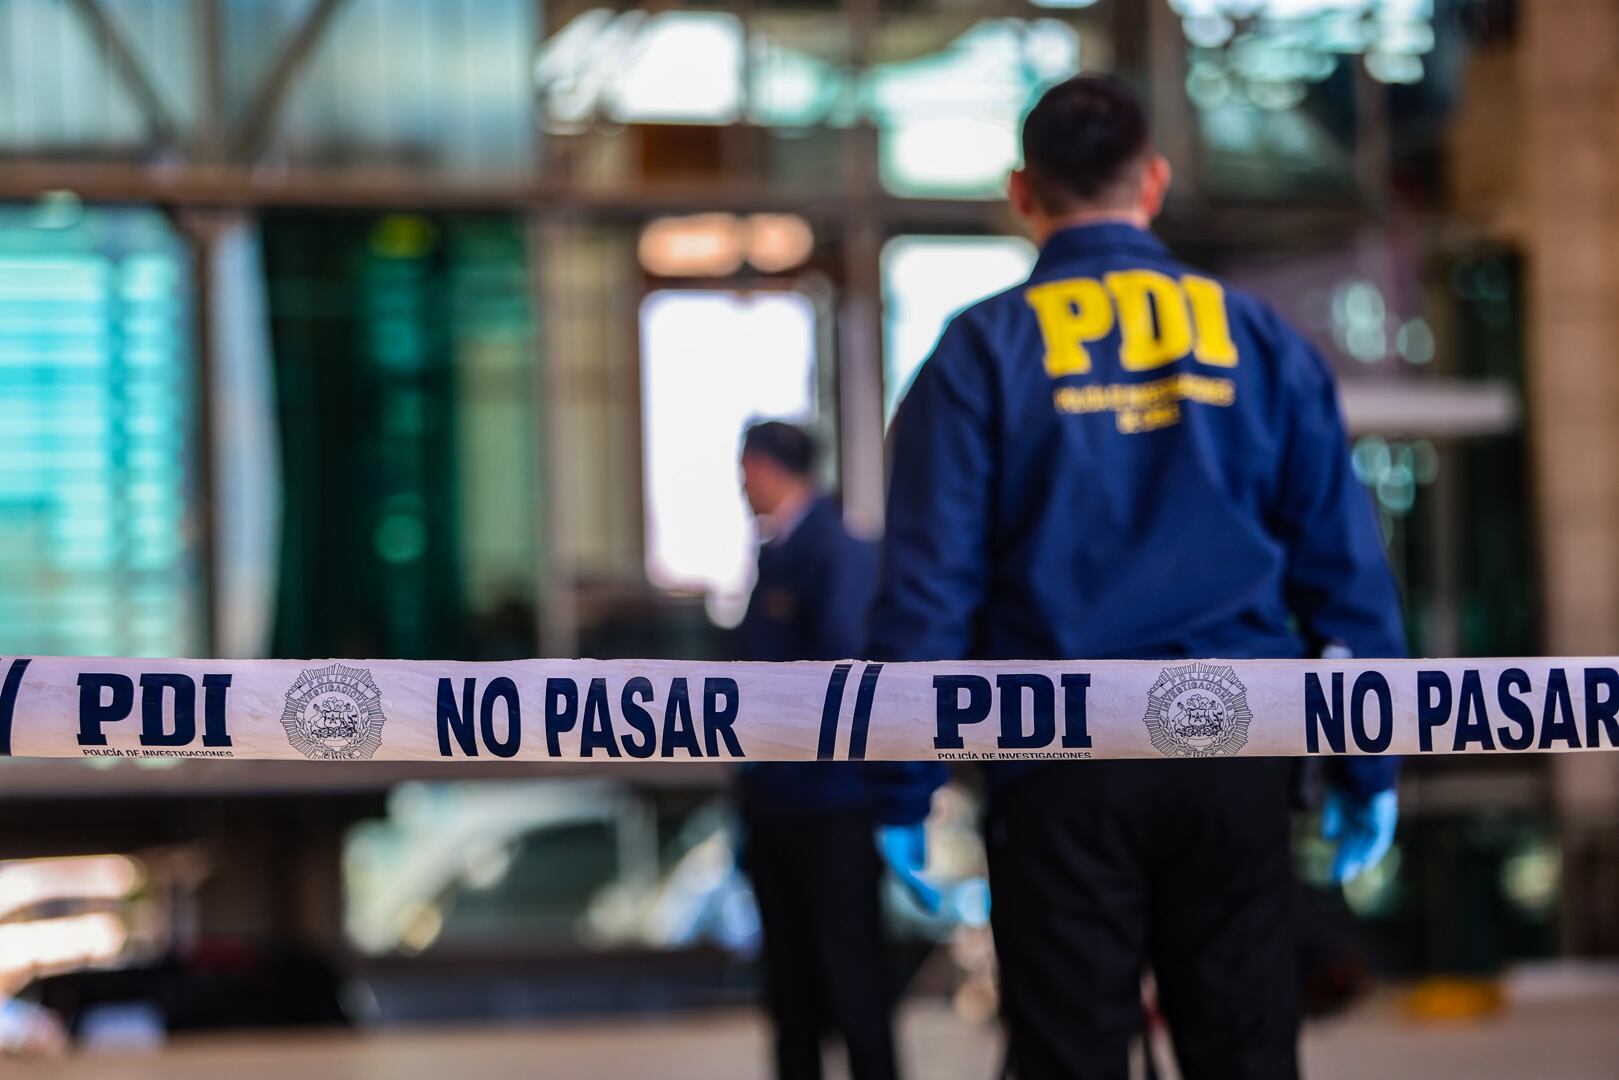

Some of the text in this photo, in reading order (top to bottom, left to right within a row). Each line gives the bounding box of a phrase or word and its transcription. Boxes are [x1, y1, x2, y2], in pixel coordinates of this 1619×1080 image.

[1024, 269, 1239, 378] PDI
[77, 673, 233, 747] PDI
[437, 677, 745, 758] NO PASAR
[933, 674, 1093, 749] PDI
[1305, 667, 1619, 753] NO PASAR
[82, 747, 234, 758] POLICÍA DE INVESTIGACIONES
[937, 750, 1092, 760] POLICÍA DE INVESTIGACIONES
